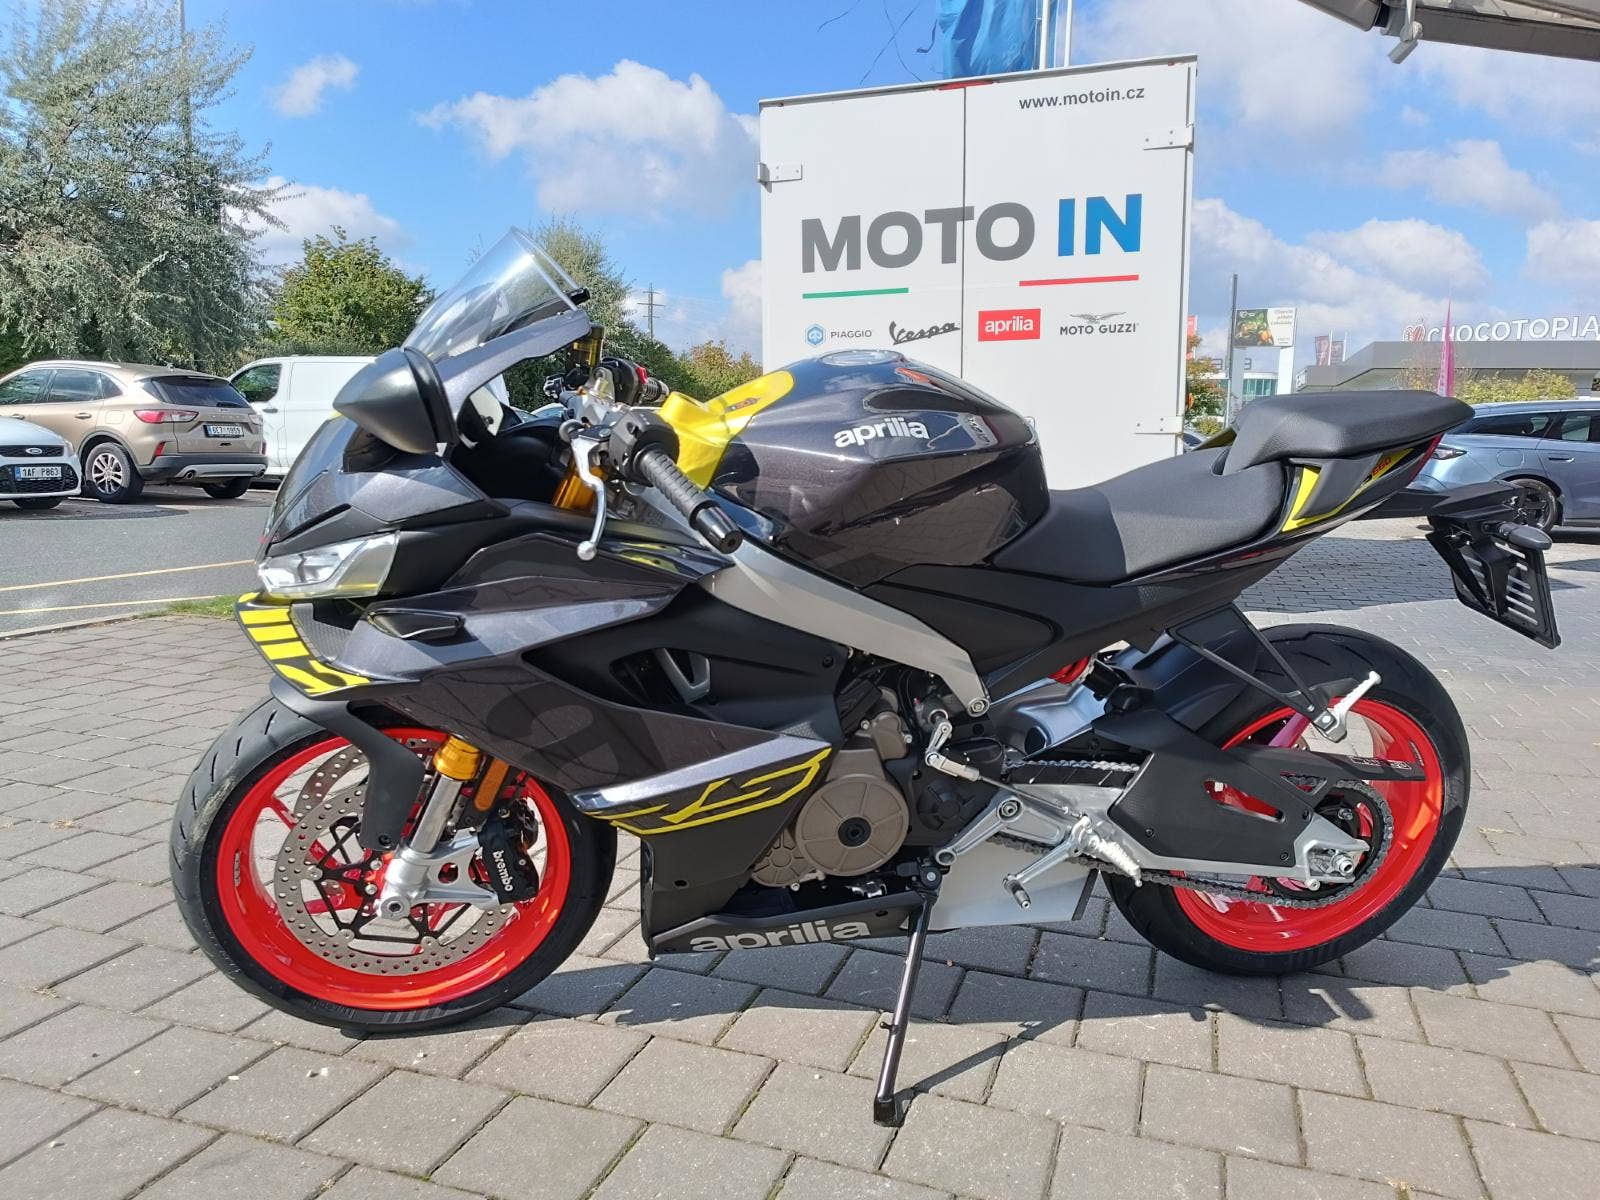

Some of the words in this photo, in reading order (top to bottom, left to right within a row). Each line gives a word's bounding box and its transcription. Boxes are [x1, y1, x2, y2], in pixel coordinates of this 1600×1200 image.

[1019, 88, 1145, 109] www.motoin.cz
[801, 202, 1035, 273] MOTO
[1058, 194, 1142, 257] IN
[830, 329, 872, 339] PIAGGIO
[889, 320, 960, 346] Vespa
[984, 315, 1034, 335] aprilia
[1060, 324, 1094, 336] MOTO
[1098, 322, 1136, 334] GUZZI
[834, 417, 931, 448] aprilia
[492, 850, 514, 892] brembo
[690, 919, 871, 952] aprilia
